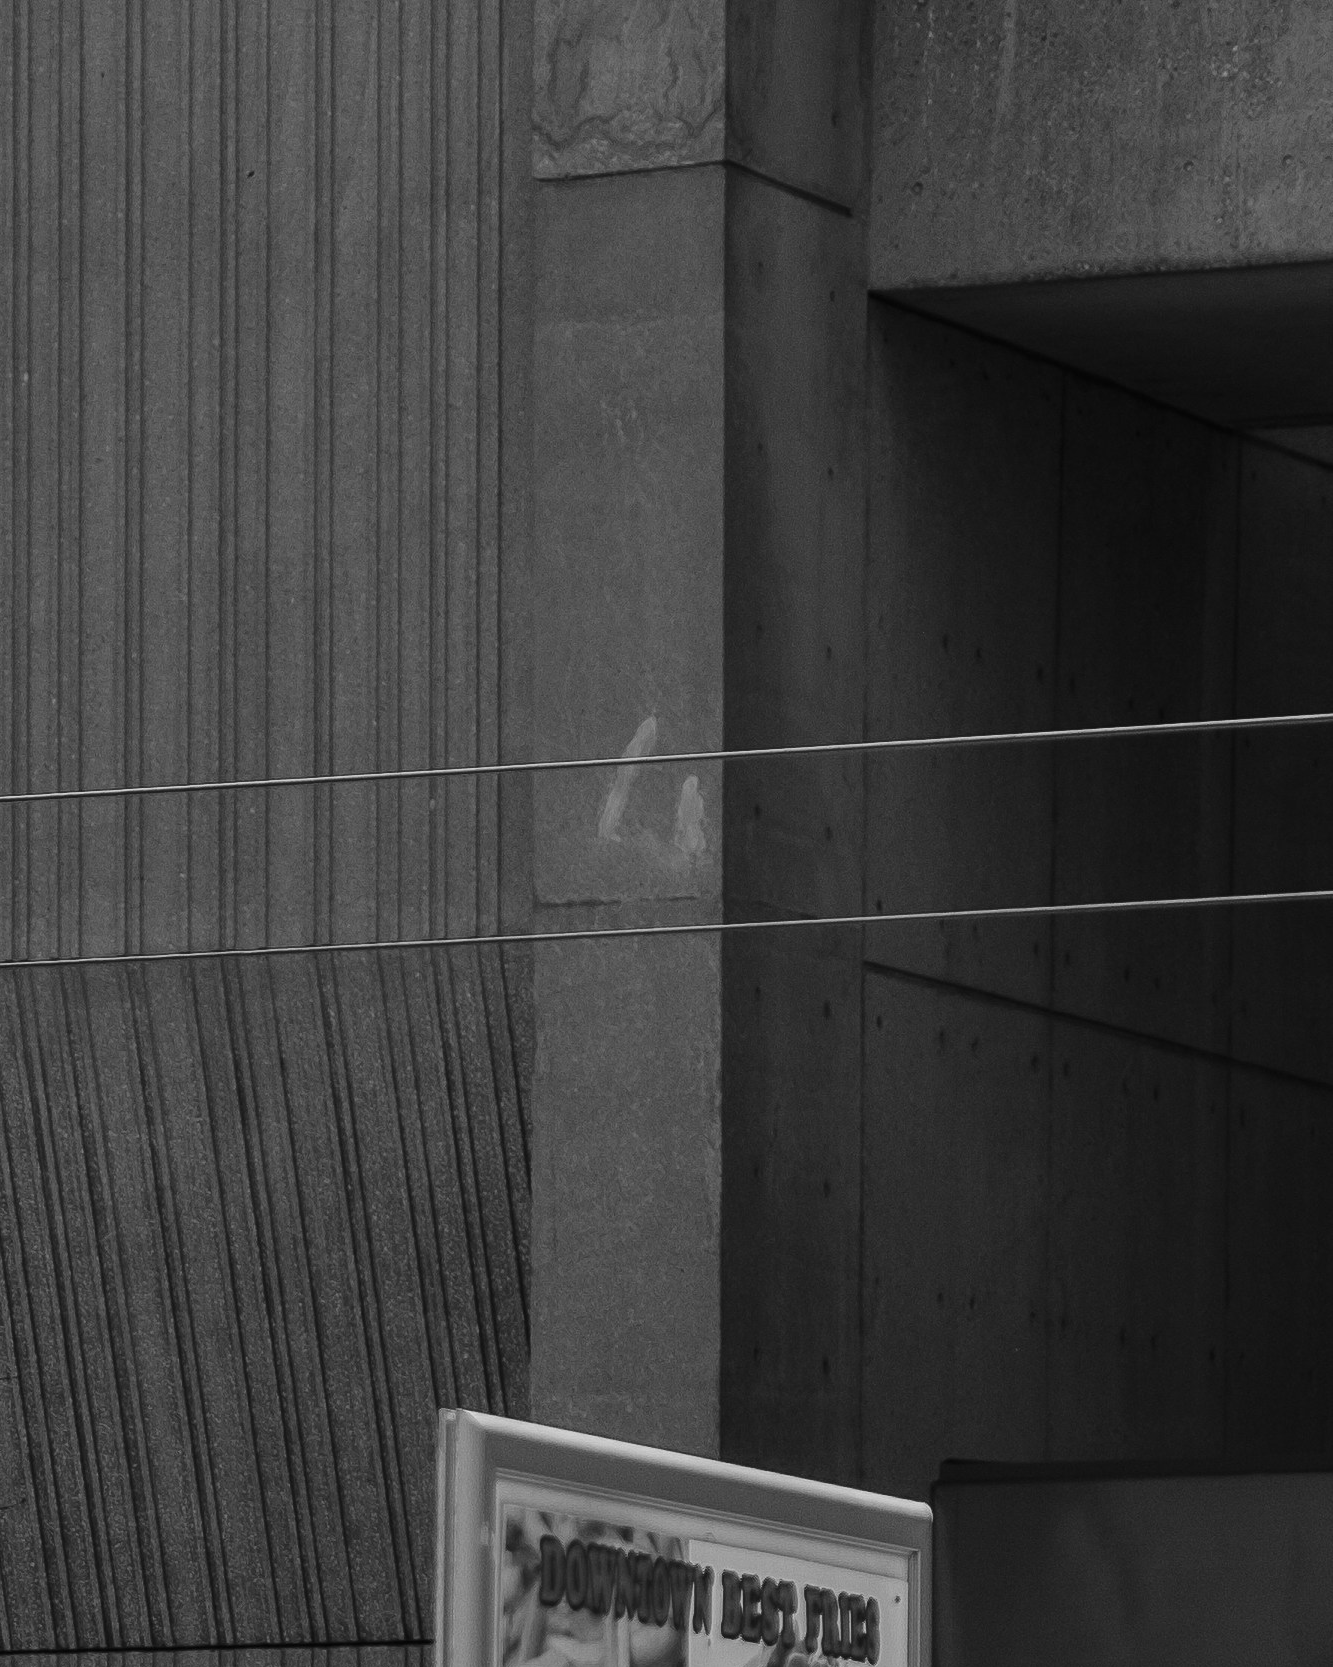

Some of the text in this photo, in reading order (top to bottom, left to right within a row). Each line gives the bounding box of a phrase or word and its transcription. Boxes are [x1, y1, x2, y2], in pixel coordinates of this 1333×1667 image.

[538, 1534, 881, 1666] DOWNTOWN BEST FRIES
